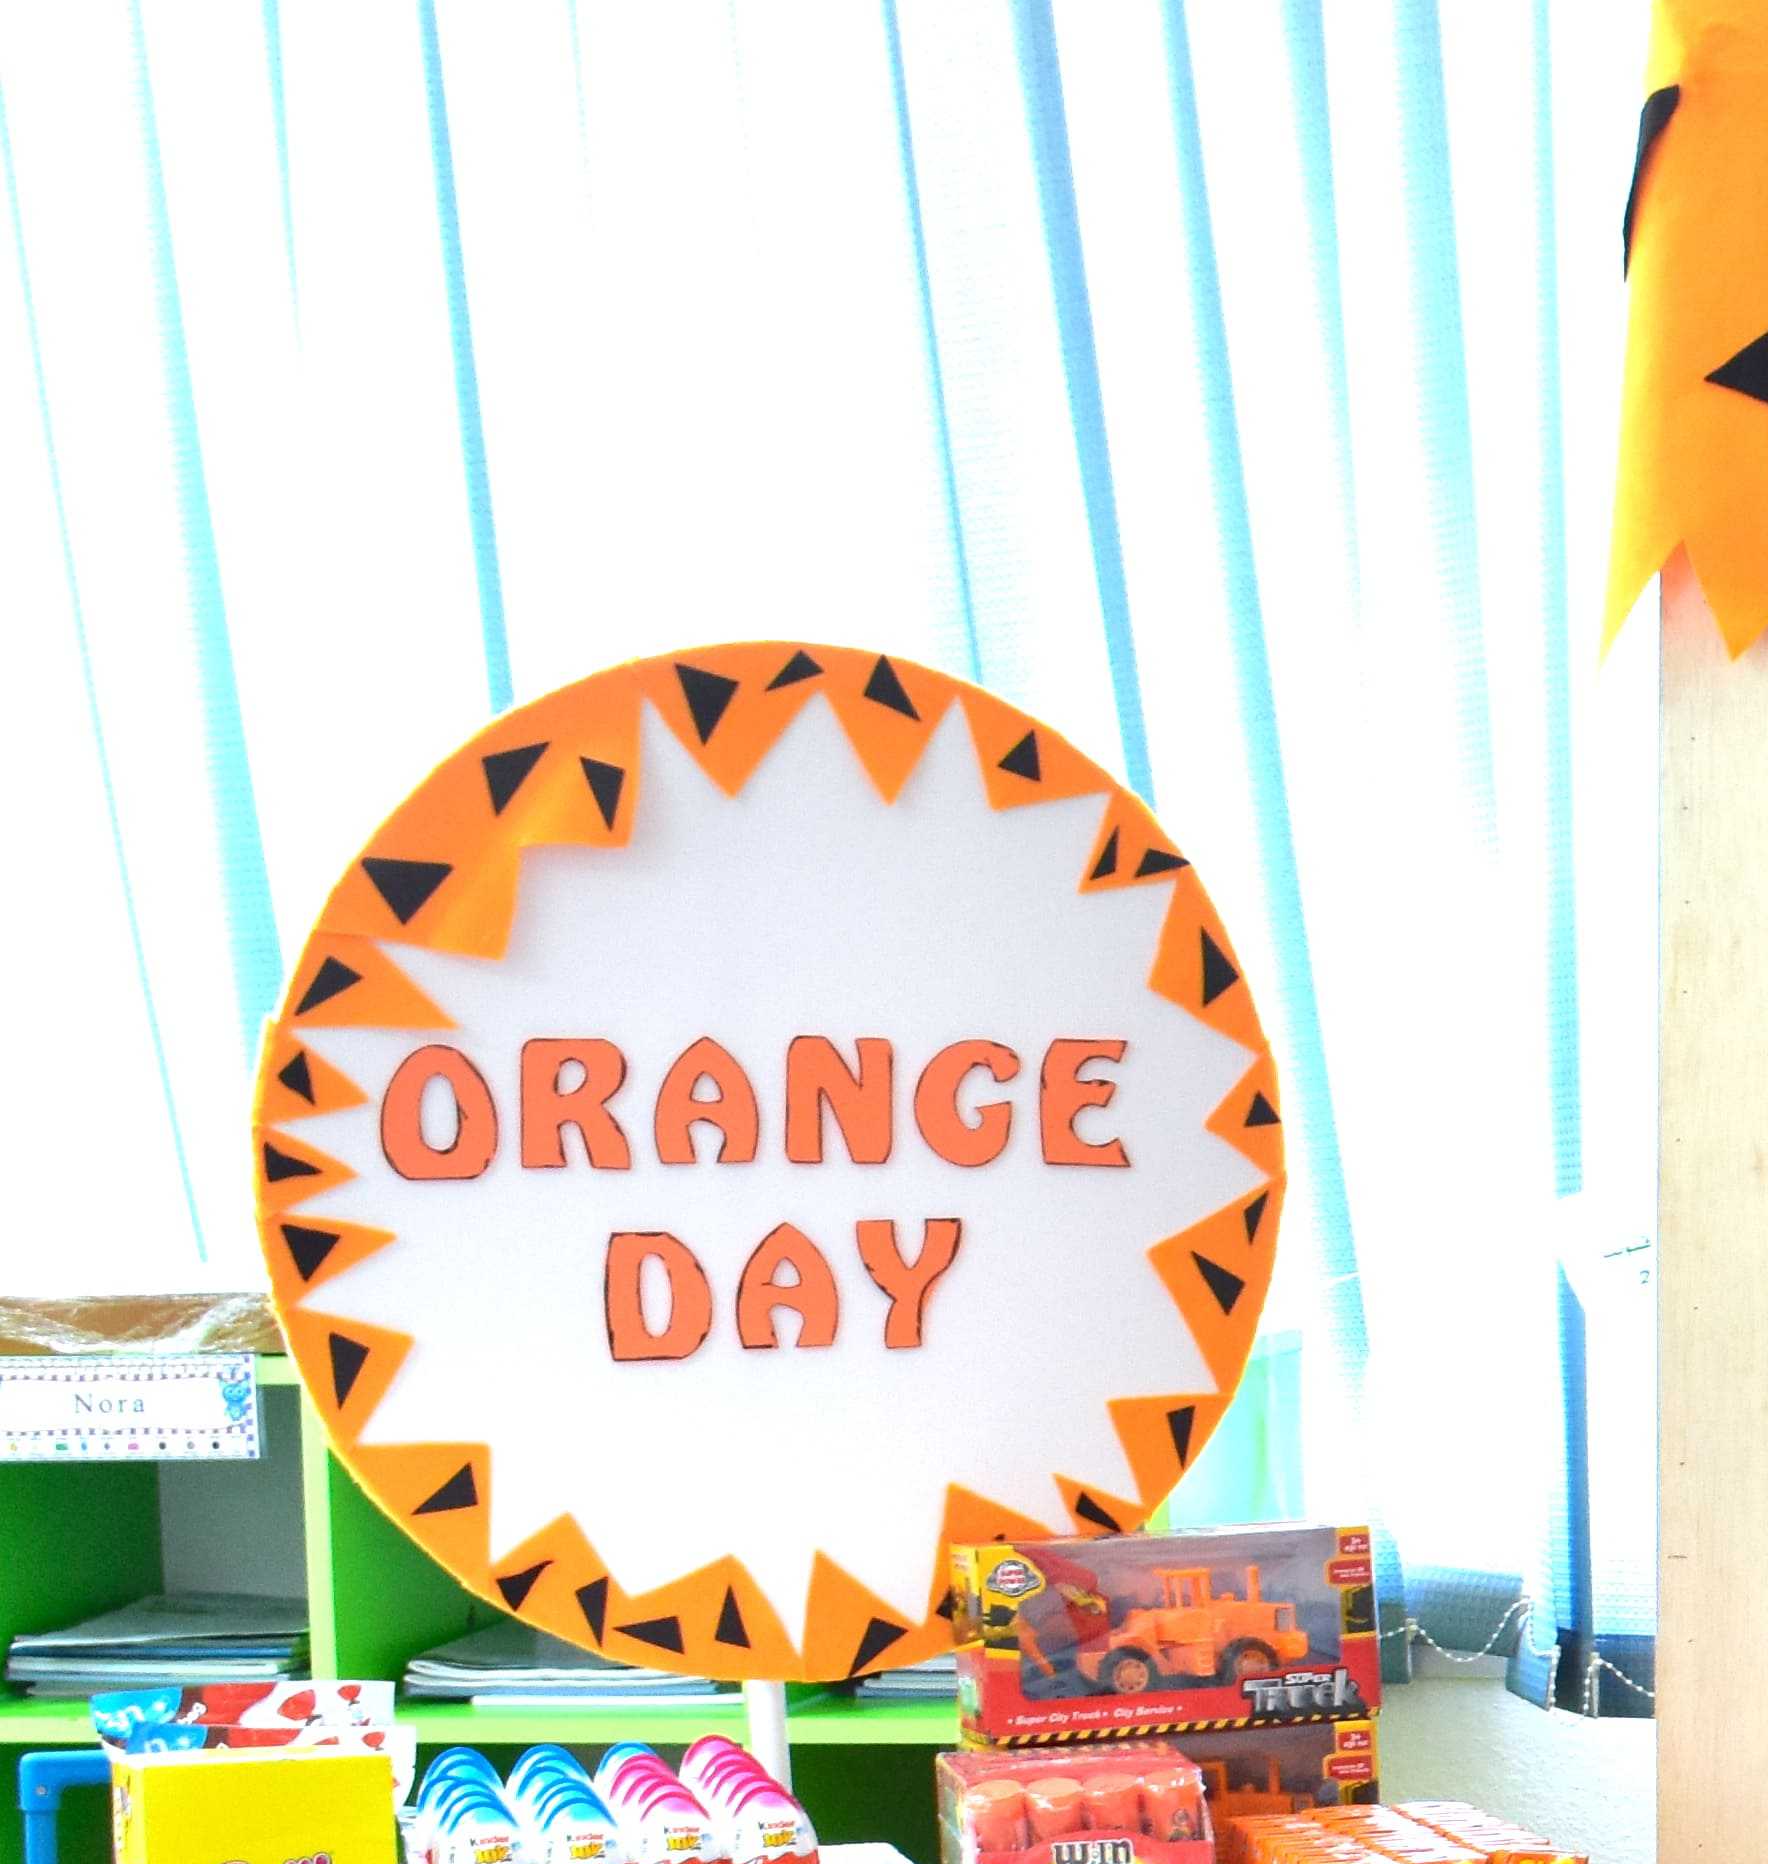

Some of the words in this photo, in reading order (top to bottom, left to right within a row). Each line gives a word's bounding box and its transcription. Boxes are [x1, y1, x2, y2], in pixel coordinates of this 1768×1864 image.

[380, 1035, 1131, 1181] ORANGE
[602, 1217, 963, 1363] DAY
[73, 1392, 145, 1414] Nora
